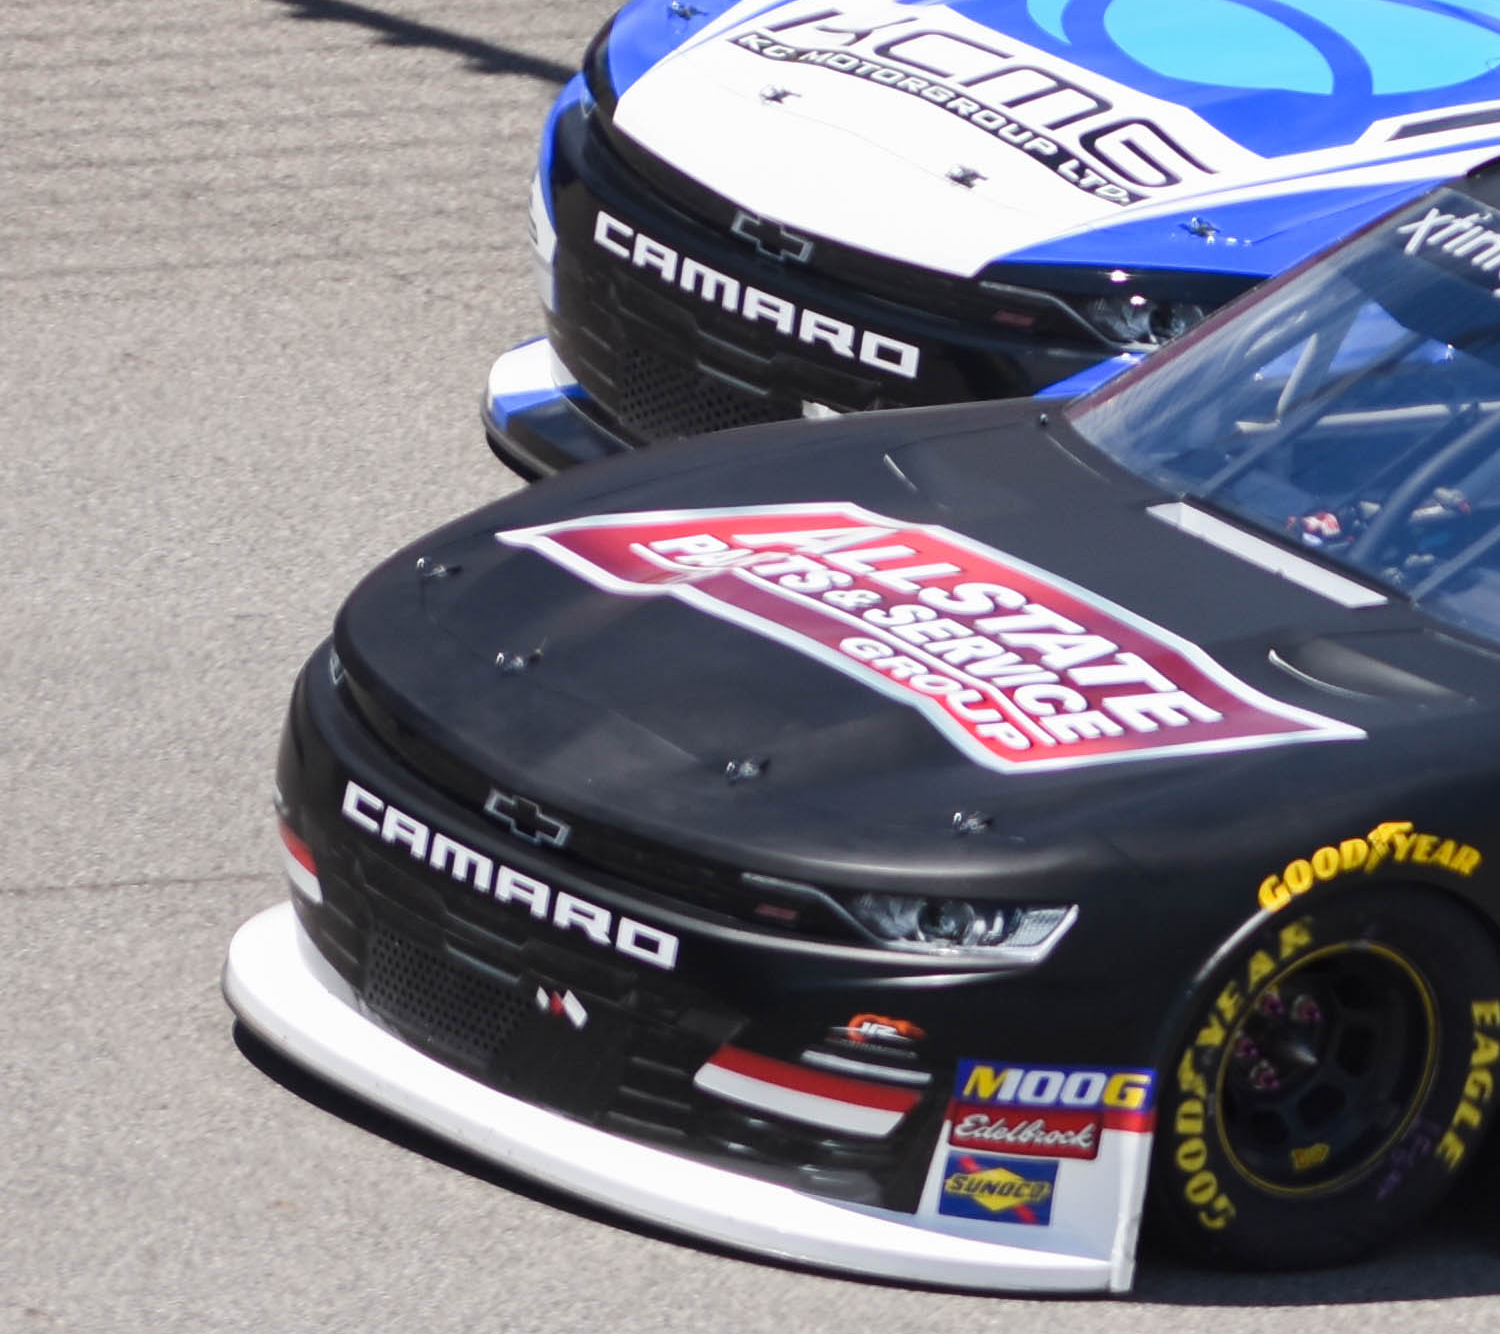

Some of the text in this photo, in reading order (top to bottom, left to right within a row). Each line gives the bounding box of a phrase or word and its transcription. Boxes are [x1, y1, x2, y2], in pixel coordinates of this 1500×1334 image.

[736, 30, 1134, 207] KC MOTORGROUP LTD.
[765, 8, 1220, 190] KCMG
[594, 210, 920, 380] CAMARO
[733, 524, 1224, 733] ALLSTATE
[822, 589, 882, 611] &
[862, 604, 1124, 745] SERVICE
[840, 636, 1030, 751] GROUP
[340, 779, 681, 973] CAMARO
[1257, 820, 1483, 913] GOODYEAR
[954, 1113, 1096, 1150] Edelbrock
[962, 1065, 1153, 1110] MOOG
[1175, 916, 1315, 1231] GOODYEAR
[946, 1171, 1054, 1200] SUNOCO
